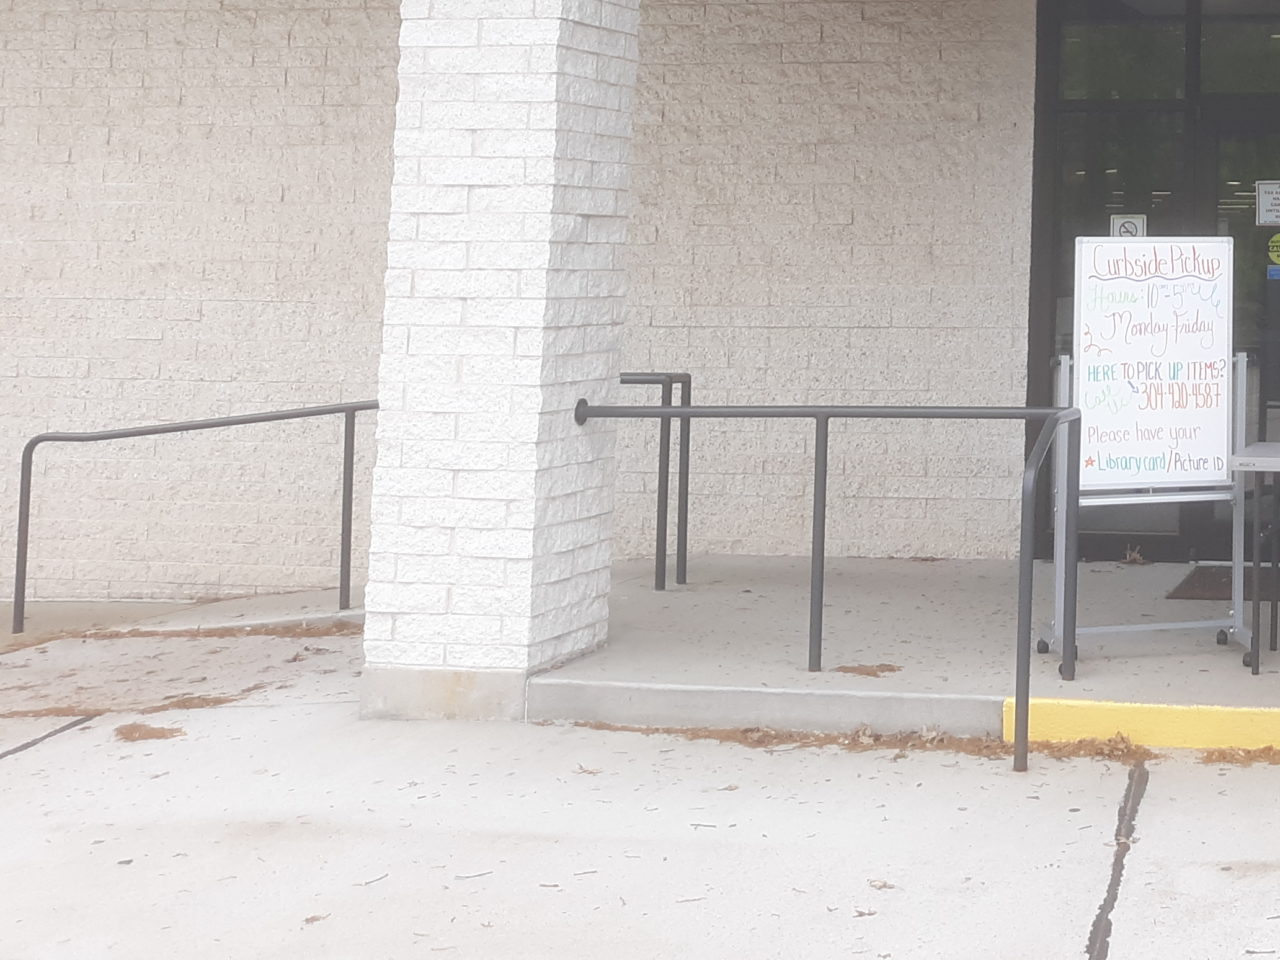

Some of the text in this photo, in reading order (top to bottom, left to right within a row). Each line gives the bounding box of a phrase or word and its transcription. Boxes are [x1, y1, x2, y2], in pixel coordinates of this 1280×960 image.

[1094, 244, 1220, 278] Curbside Pickup
[1088, 358, 1226, 382] HERE TO PICK UP ITEMS?
[1088, 421, 1201, 450] Please have your
[1213, 456, 1224, 471] ID
